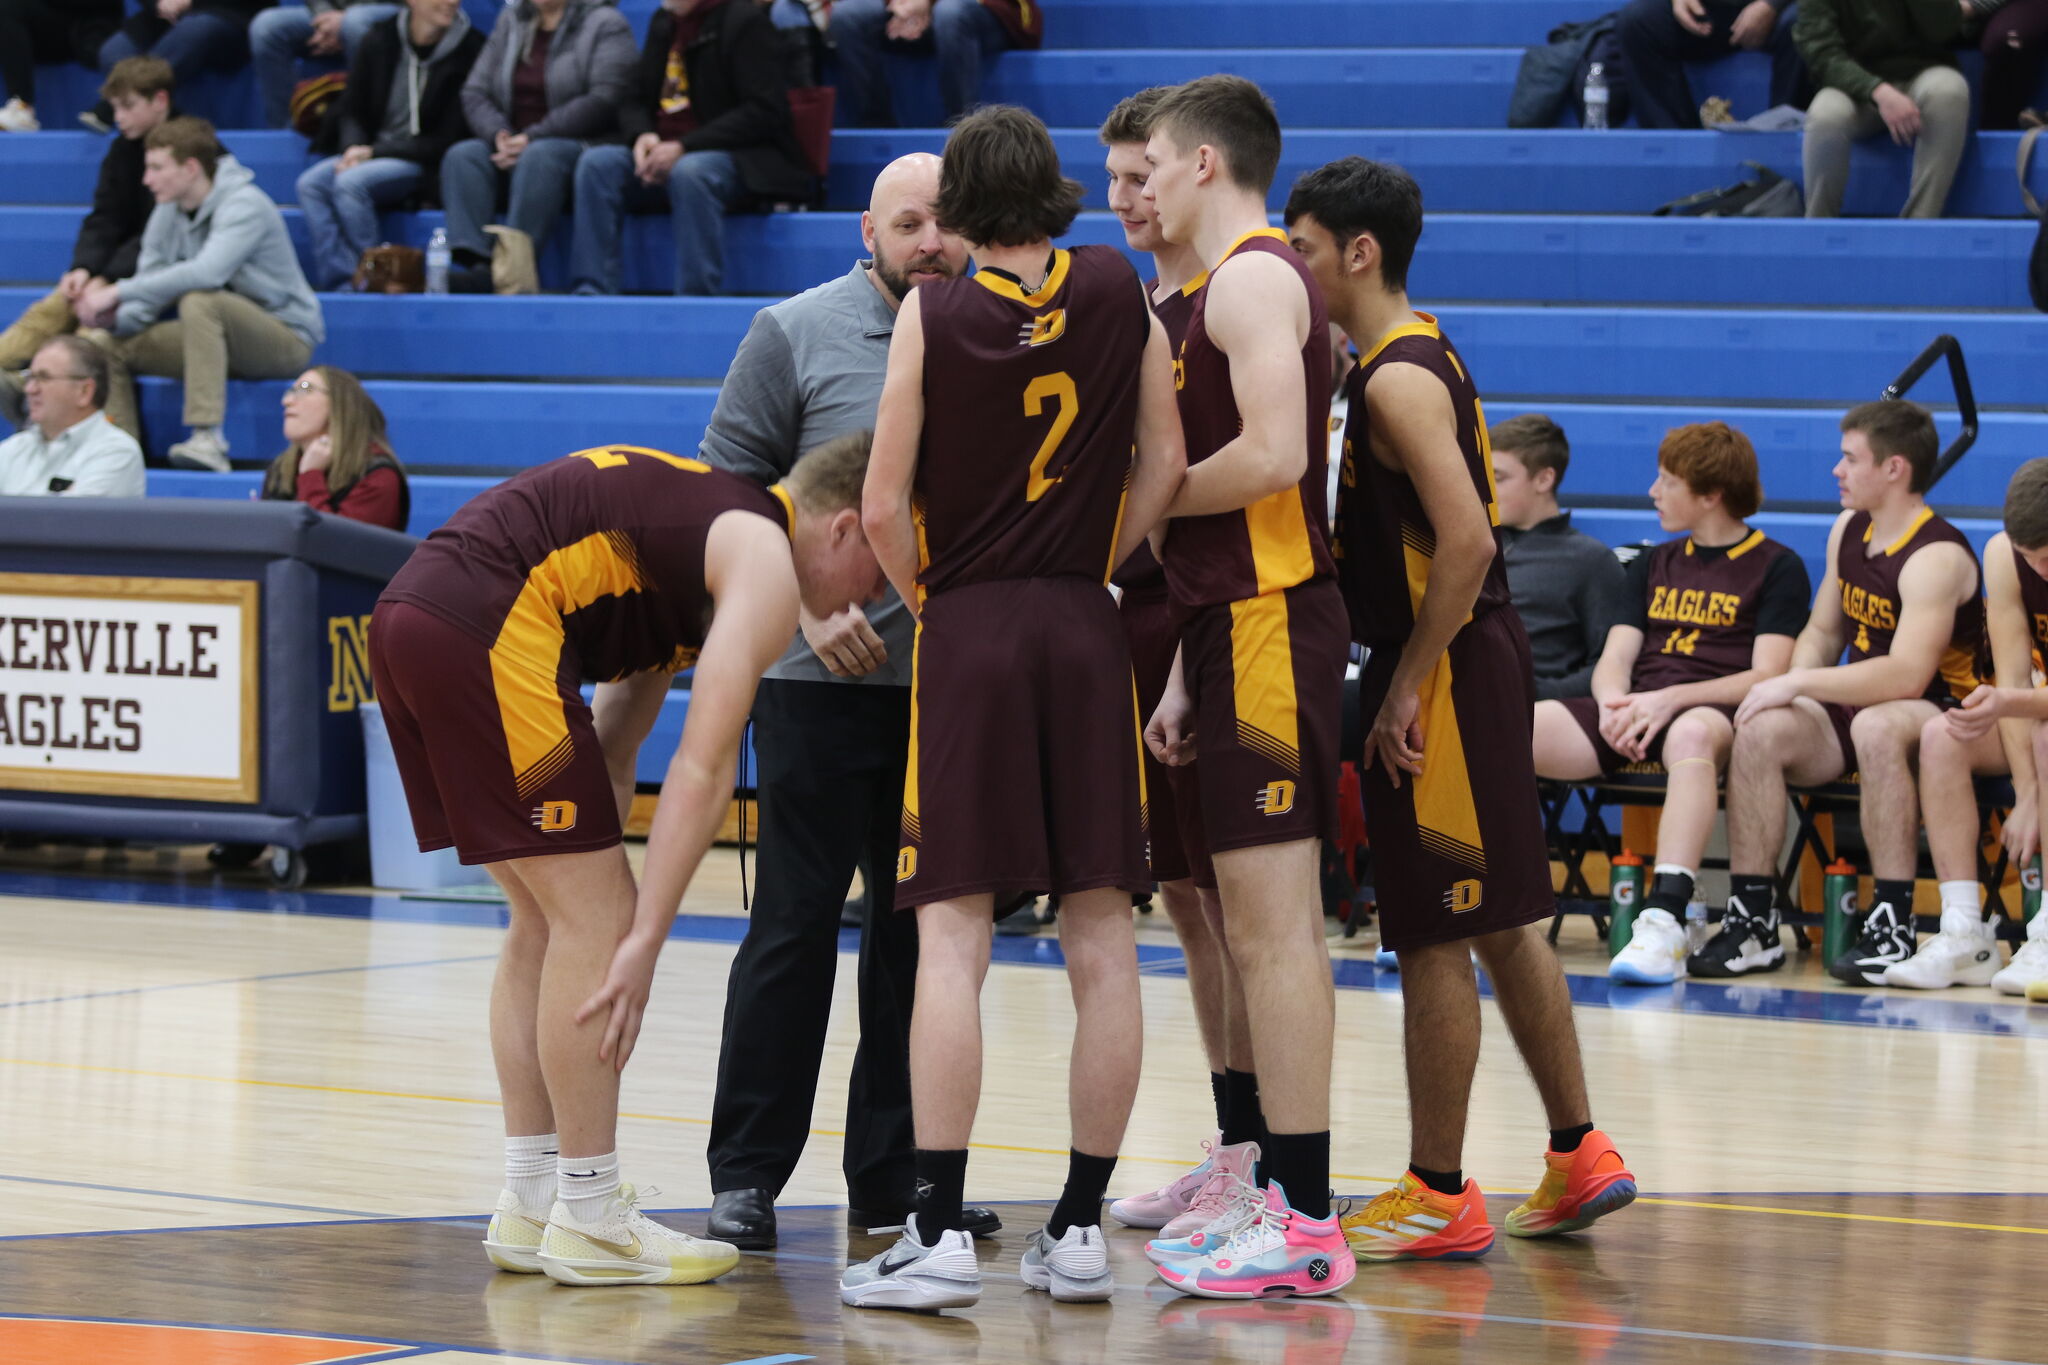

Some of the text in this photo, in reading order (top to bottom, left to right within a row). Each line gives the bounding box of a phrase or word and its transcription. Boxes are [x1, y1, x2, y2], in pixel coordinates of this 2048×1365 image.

[1023, 371, 1079, 502] 2
[1647, 585, 1741, 627] EAGLES
[1839, 578, 1896, 630] AGLES
[1660, 628, 1701, 656] 14
